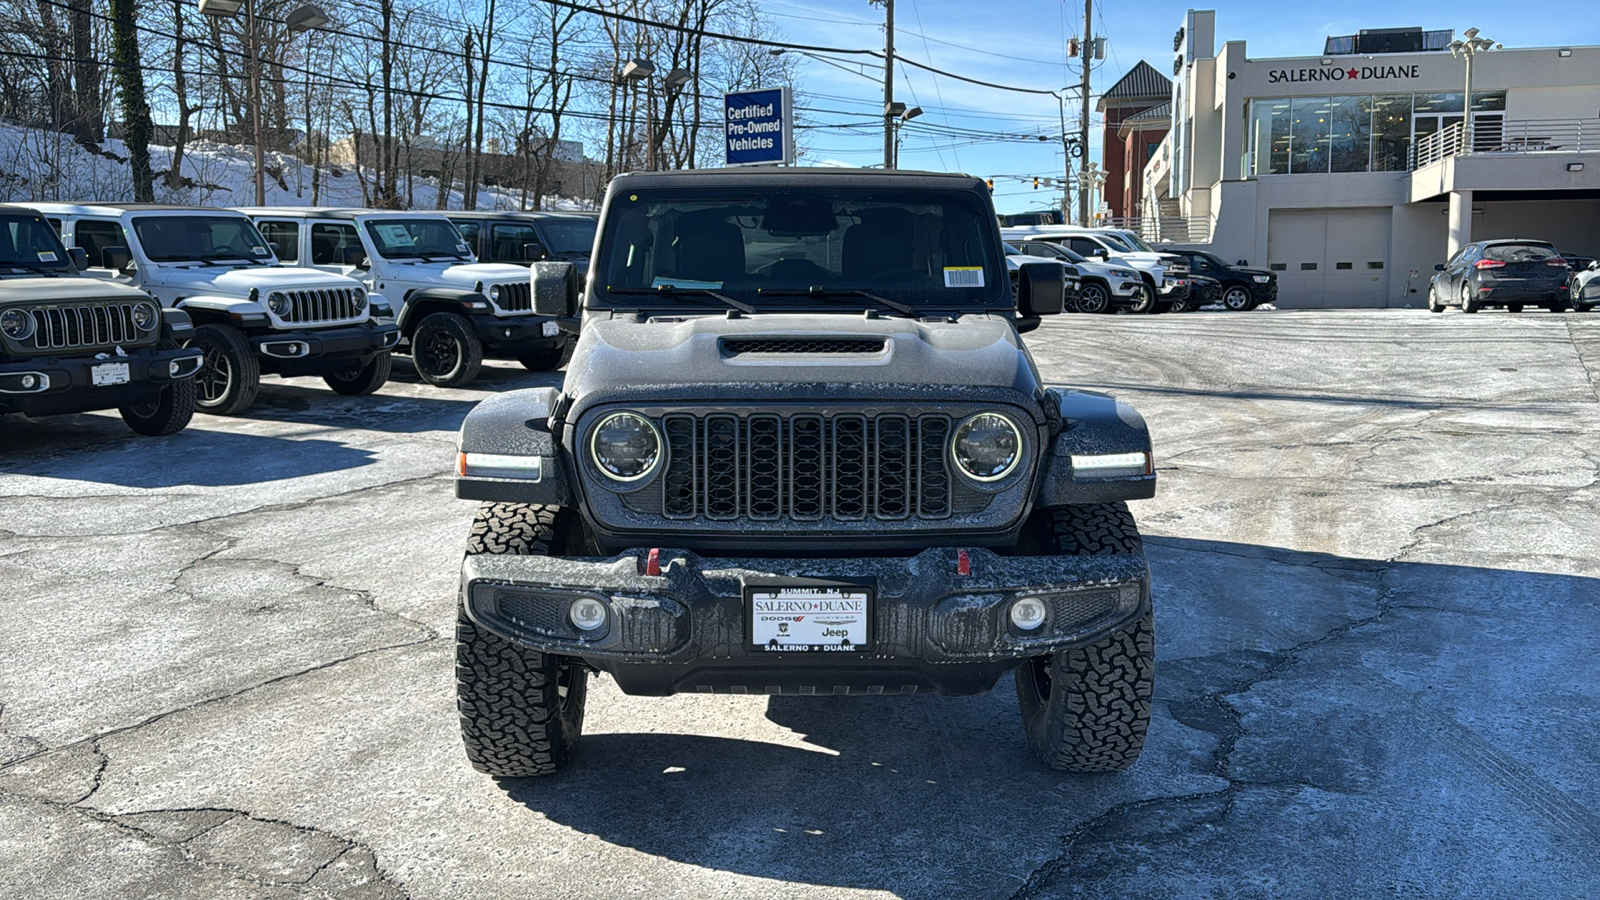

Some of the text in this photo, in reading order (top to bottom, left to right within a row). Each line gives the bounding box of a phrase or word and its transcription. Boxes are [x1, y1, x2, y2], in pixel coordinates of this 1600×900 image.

[1268, 65, 1420, 83] SALERNO DUANE
[728, 103, 773, 119] Certified
[728, 119, 780, 135] Pre-Owned
[728, 136, 773, 151] Vehicles
[755, 601, 862, 611] SALERNO DUANE
[822, 628, 848, 638] Jeep
